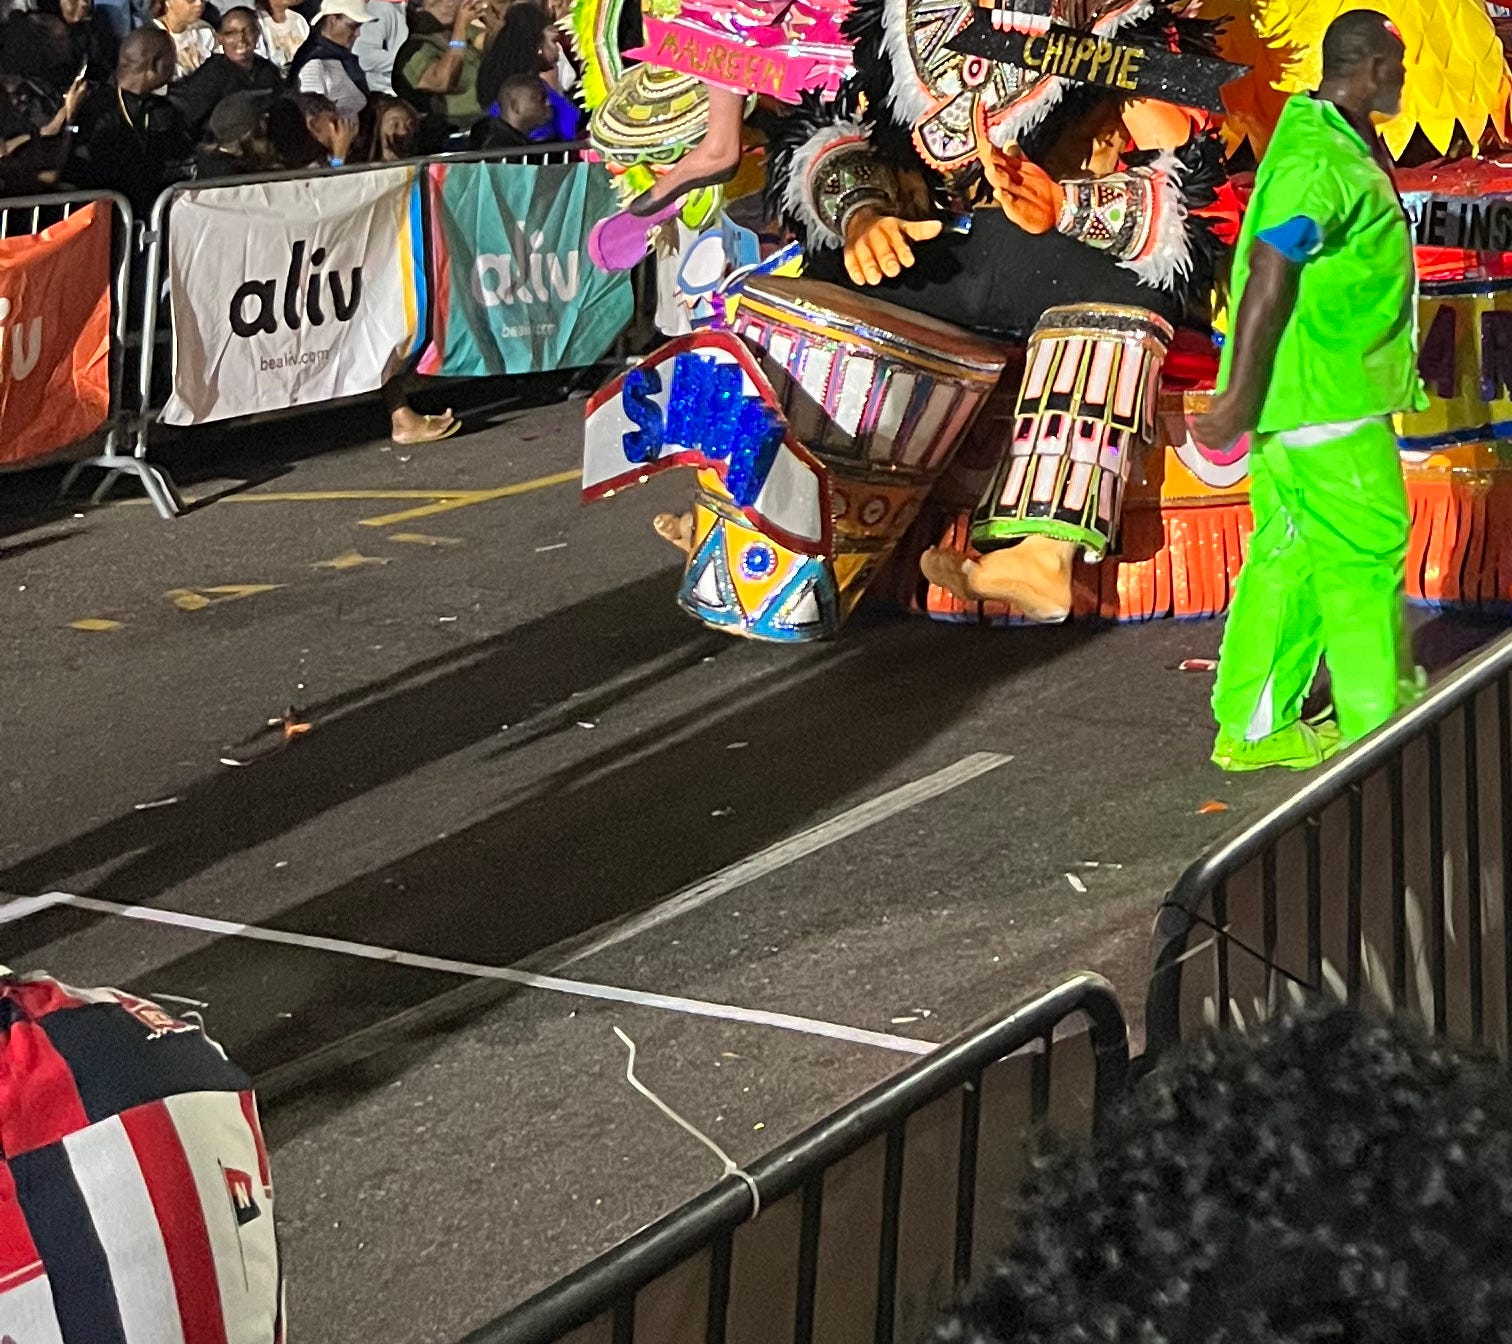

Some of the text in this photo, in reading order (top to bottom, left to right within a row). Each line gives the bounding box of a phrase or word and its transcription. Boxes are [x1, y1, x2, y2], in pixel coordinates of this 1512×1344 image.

[656, 30, 786, 93] MAUREEN
[1022, 31, 1147, 91] CHIPPIE
[229, 239, 363, 338] aliv
[259, 348, 330, 372] bealiv.com
